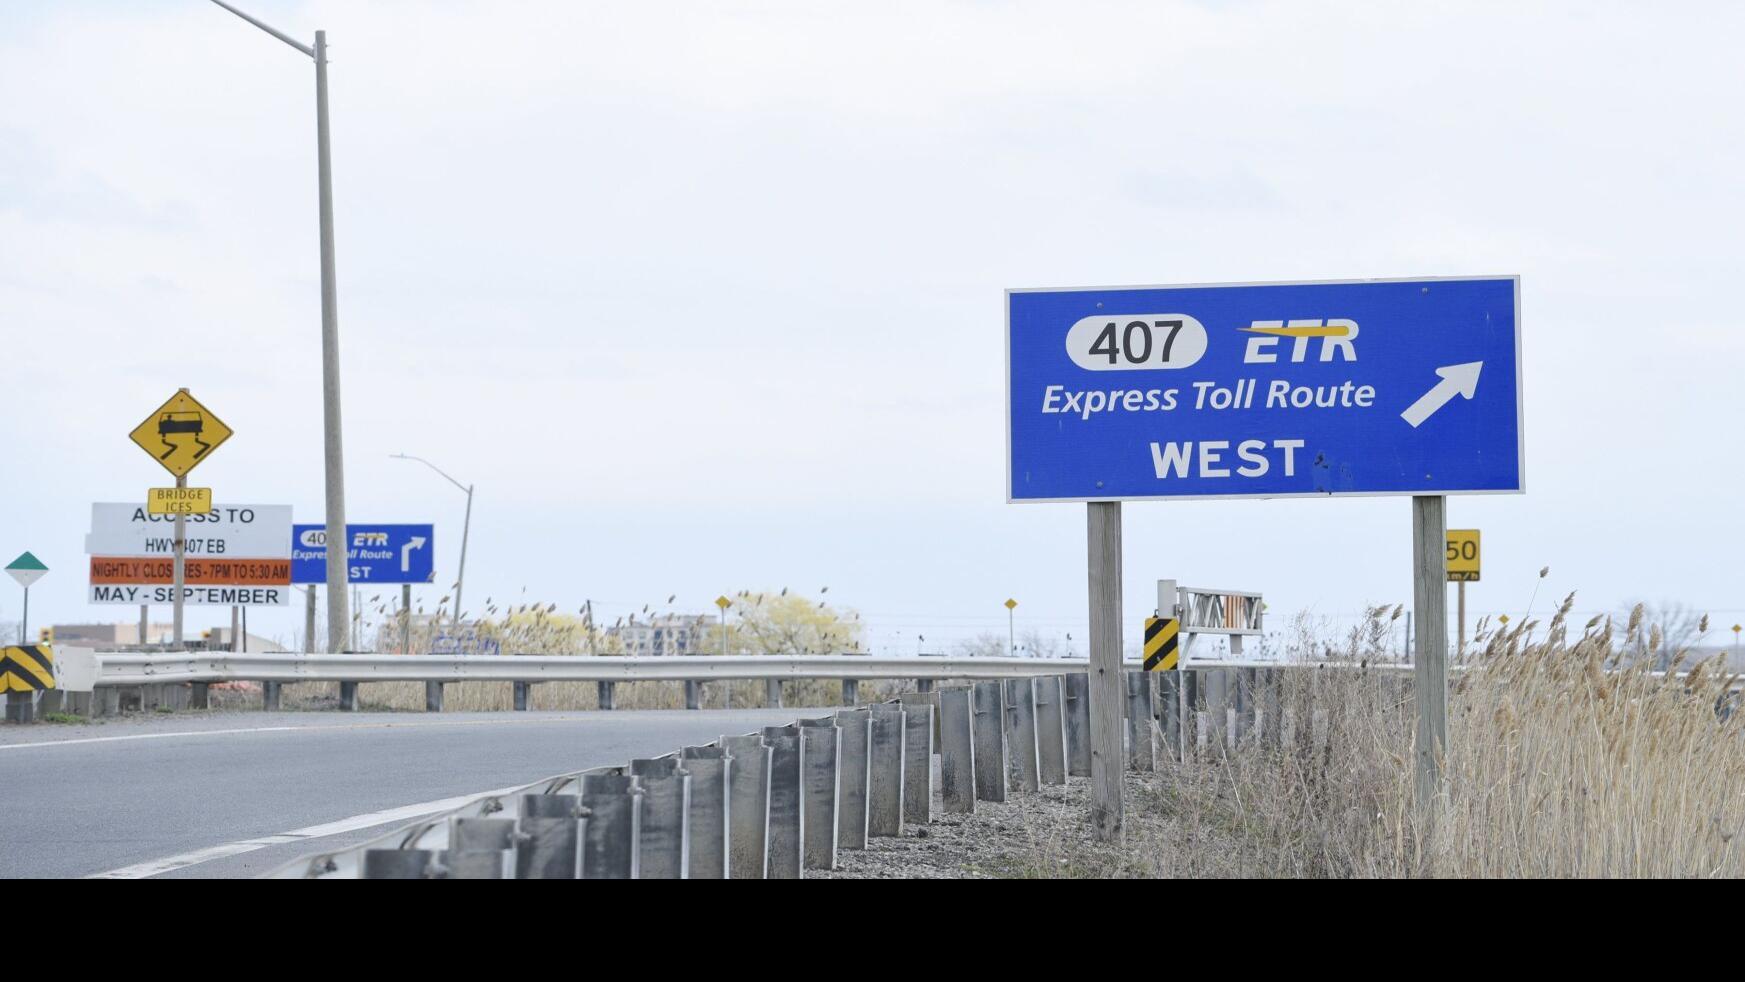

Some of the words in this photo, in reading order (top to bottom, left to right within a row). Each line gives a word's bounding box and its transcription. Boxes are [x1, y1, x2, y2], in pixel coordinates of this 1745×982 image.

[1088, 320, 1183, 365] 407
[1241, 318, 1360, 364] ETR
[1042, 384, 1178, 420] Express
[1191, 378, 1256, 410] Toll
[1265, 379, 1376, 409] Route
[1150, 439, 1305, 479] WEST
[157, 489, 204, 500] BRIDGE
[165, 502, 192, 512] ICES
[226, 508, 254, 523] TO
[207, 539, 225, 554] EB
[306, 532, 327, 545] 40
[353, 532, 388, 546] ETR
[360, 550, 393, 559] Route
[1446, 541, 1477, 561] 50
[92, 563, 139, 578] NIGHTLY
[210, 564, 231, 579] 7PM
[233, 564, 248, 579] TO
[249, 565, 270, 579] 5:30
[271, 566, 289, 580] AM
[94, 587, 139, 601] MAY
